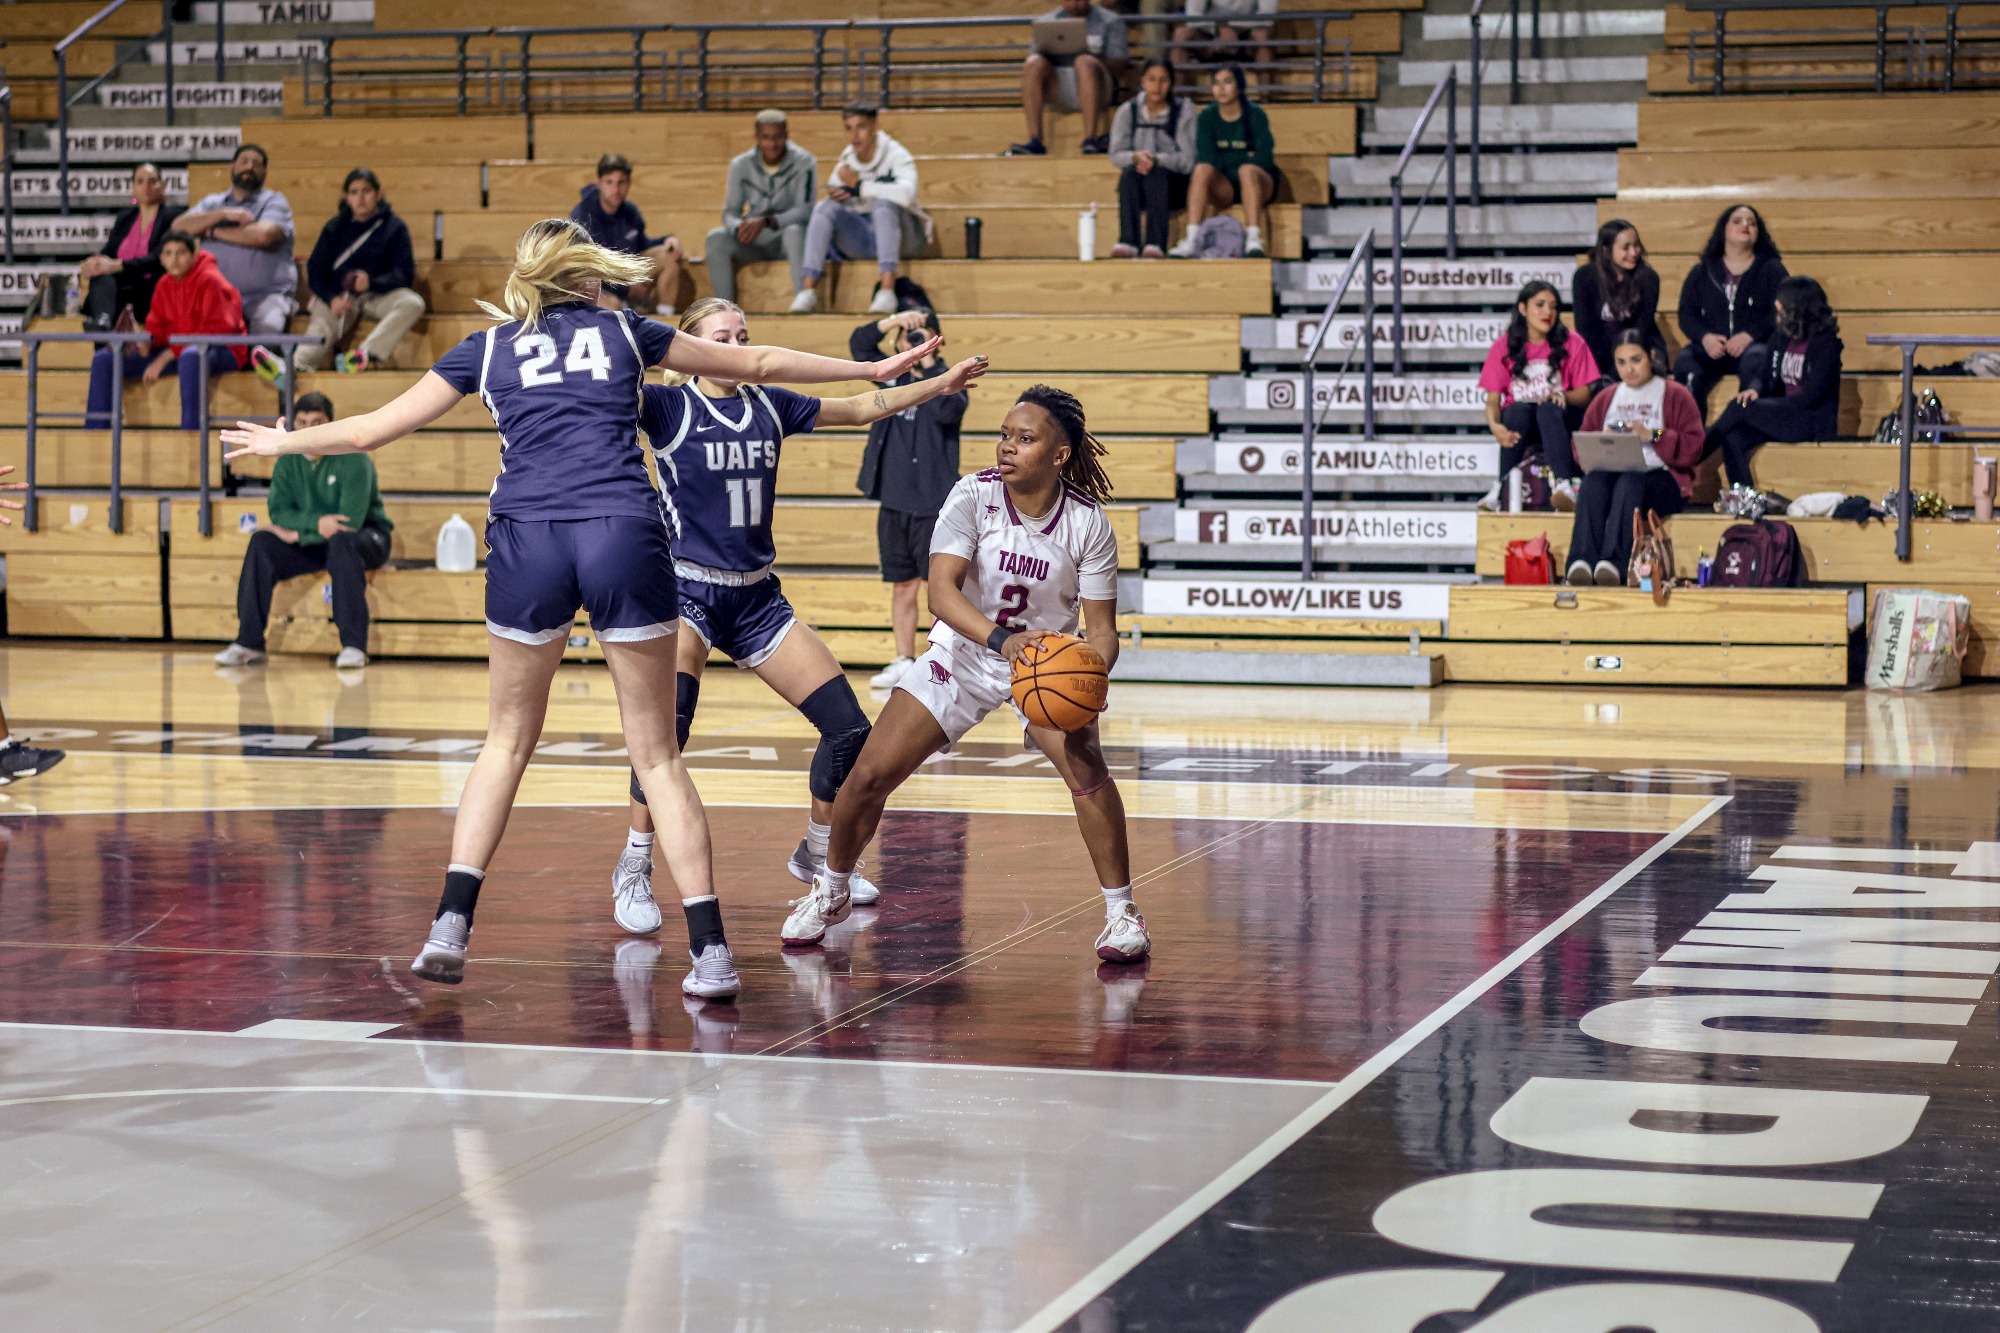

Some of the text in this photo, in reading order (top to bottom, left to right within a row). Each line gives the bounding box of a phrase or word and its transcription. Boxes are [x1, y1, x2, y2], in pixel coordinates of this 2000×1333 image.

[259, 3, 332, 22] TAMIU
[111, 89, 163, 104] FIGHT
[103, 136, 154, 149] PRIDE
[162, 136, 185, 149] OF
[13, 178, 49, 191] ET'S
[514, 326, 612, 389] 24
[703, 440, 775, 471] UAFS
[1282, 450, 1477, 473] @AMIUAthletics
[726, 478, 762, 527] 11
[999, 550, 1049, 581] TAMIU
[997, 585, 1029, 633] 2
[1187, 587, 1402, 611] FOLLOW/LIKE US
[1879, 609, 1904, 688] Marshalls
[1579, 840, 2000, 1065] TAMIU
